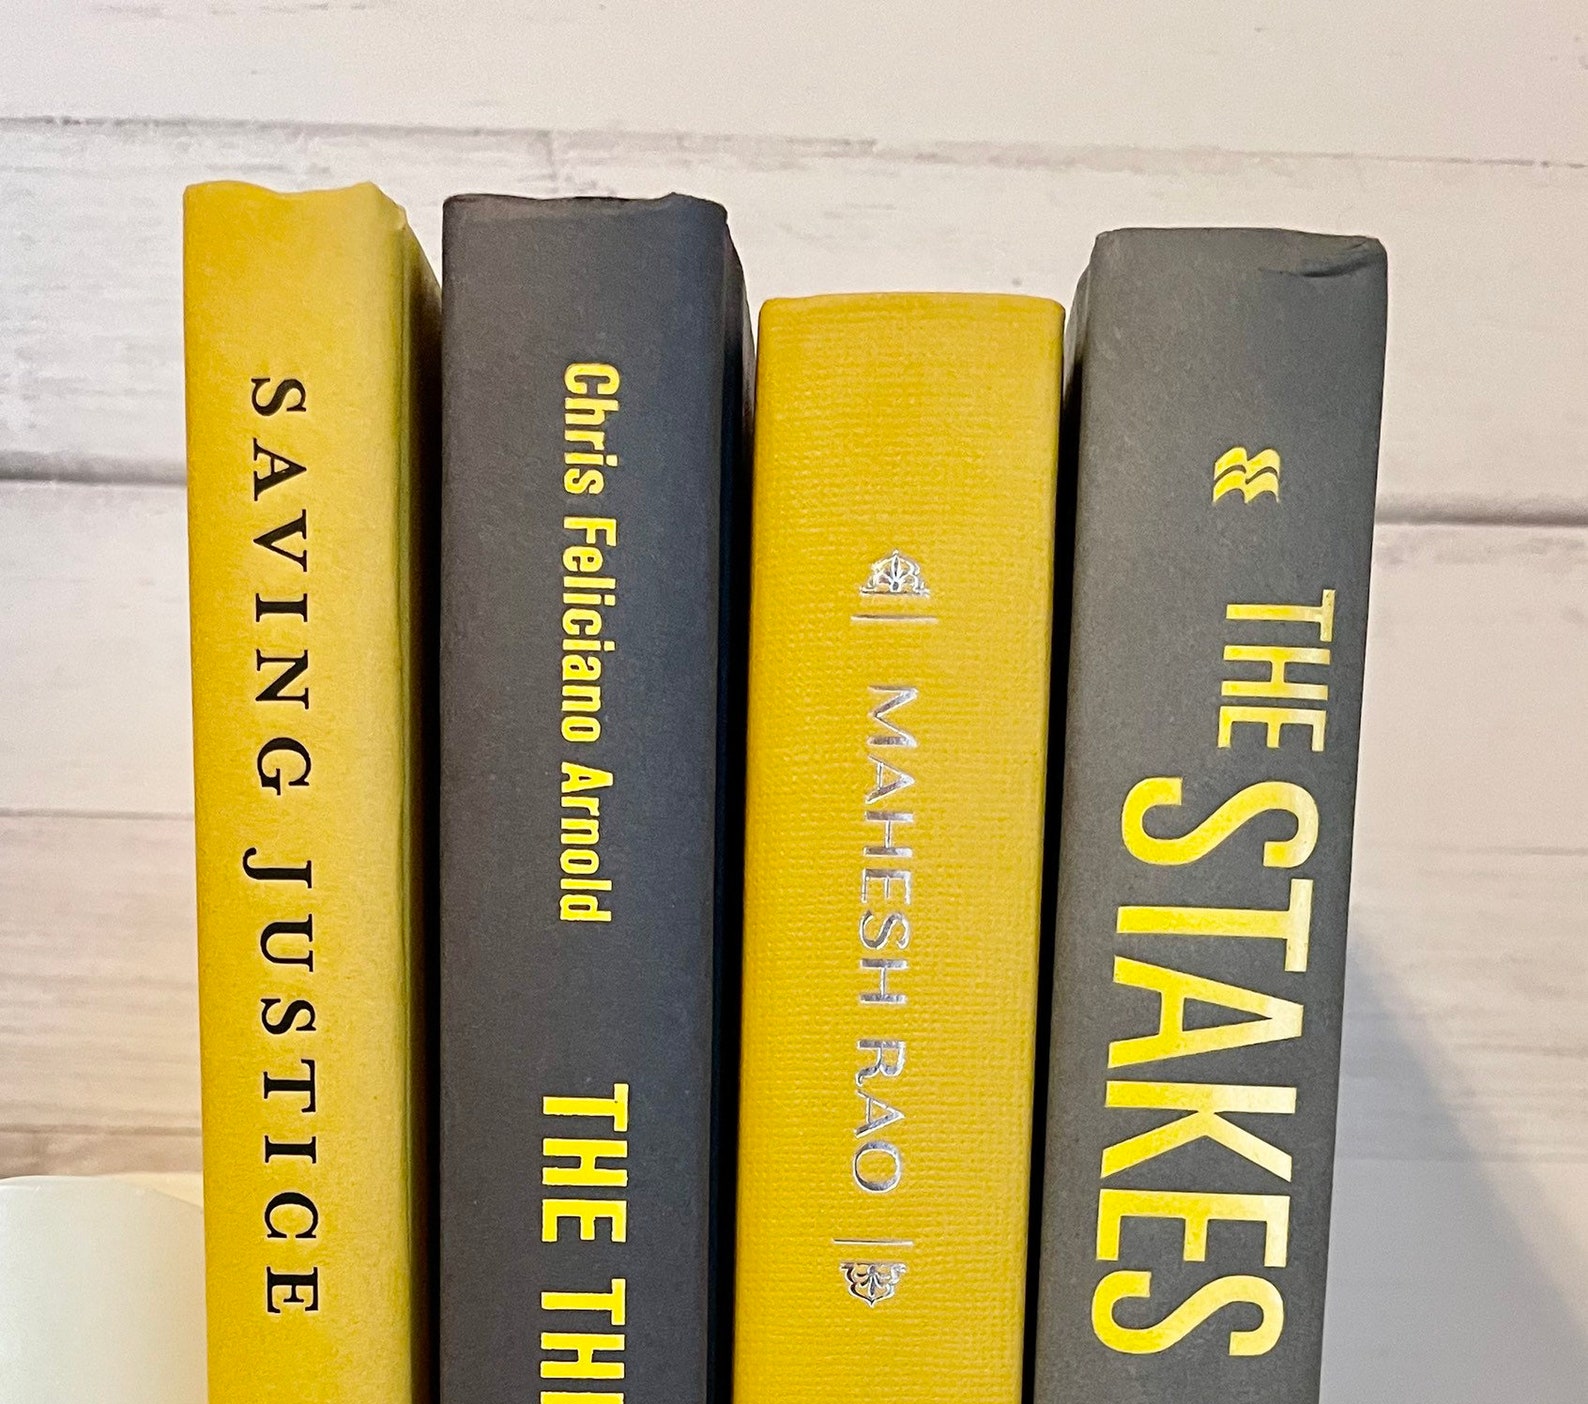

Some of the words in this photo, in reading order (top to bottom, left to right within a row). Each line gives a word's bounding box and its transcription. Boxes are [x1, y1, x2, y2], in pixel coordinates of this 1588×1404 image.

[562, 362, 622, 496] Chris
[249, 376, 313, 796] SAVING
[560, 515, 618, 744] Feliciano
[1216, 589, 1336, 750] THE
[558, 761, 614, 923] Arnold
[856, 683, 922, 1008] MAHESH
[242, 846, 320, 1315] JUSTICE
[540, 1082, 630, 1244] THE
[850, 1036, 908, 1196] RAO
[1090, 776, 1318, 1360] STAKES
